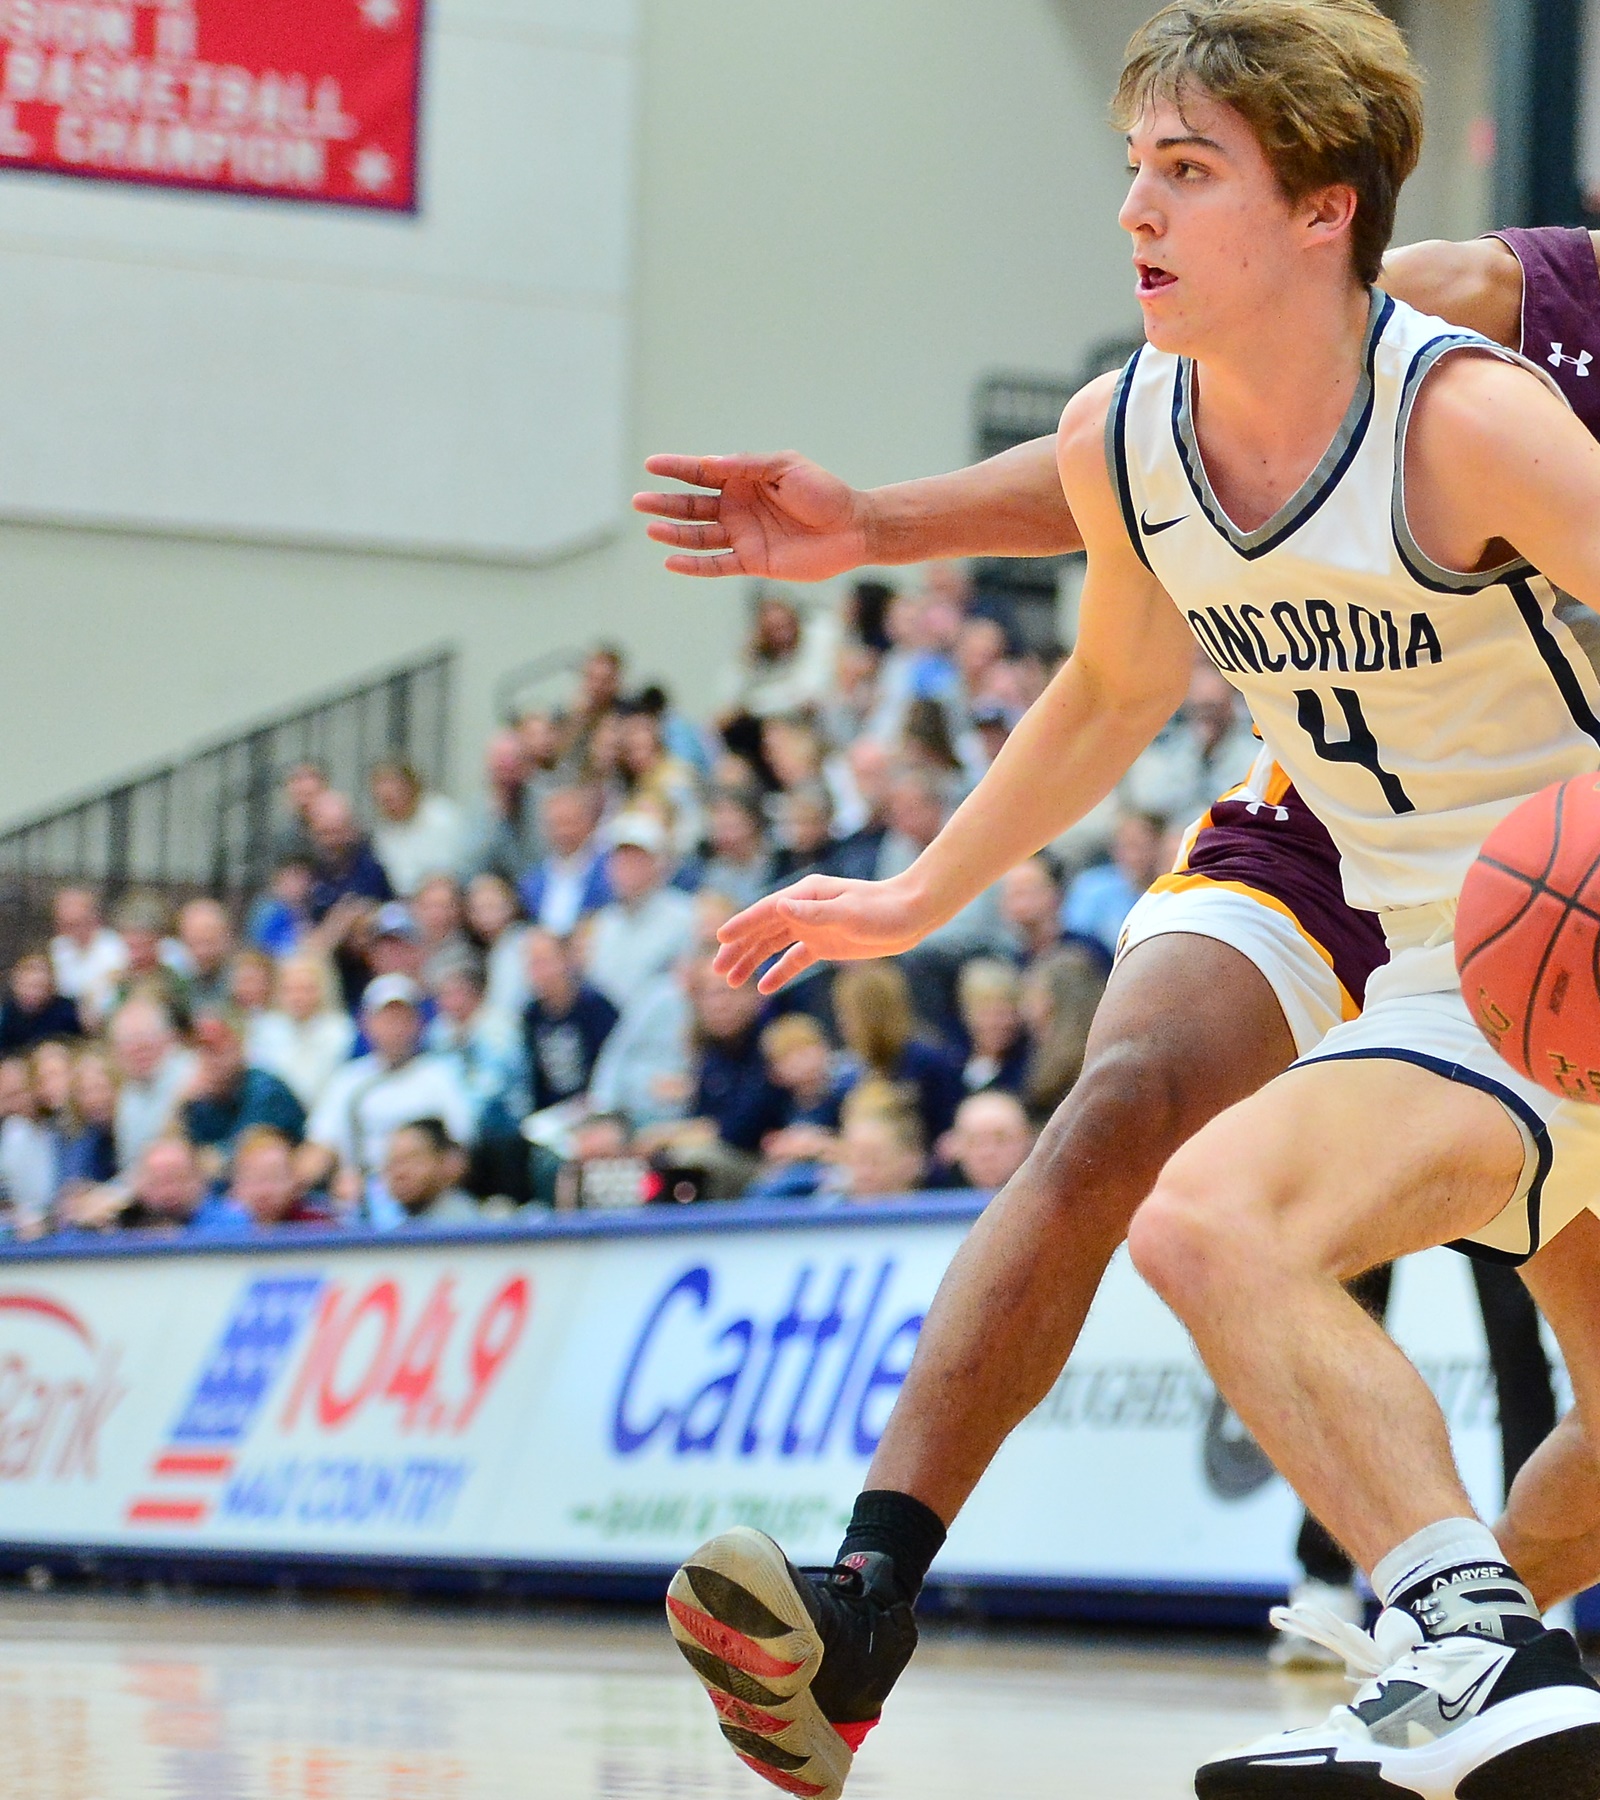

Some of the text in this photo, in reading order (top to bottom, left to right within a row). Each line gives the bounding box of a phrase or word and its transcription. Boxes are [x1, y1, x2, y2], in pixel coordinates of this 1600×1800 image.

[1188, 599, 1442, 673] ONCORDIA
[1292, 686, 1417, 815] 4
[277, 1274, 532, 1436] 104.9
[611, 1260, 926, 1456] Cattle
[1450, 1566, 1499, 1584] ARYSE
